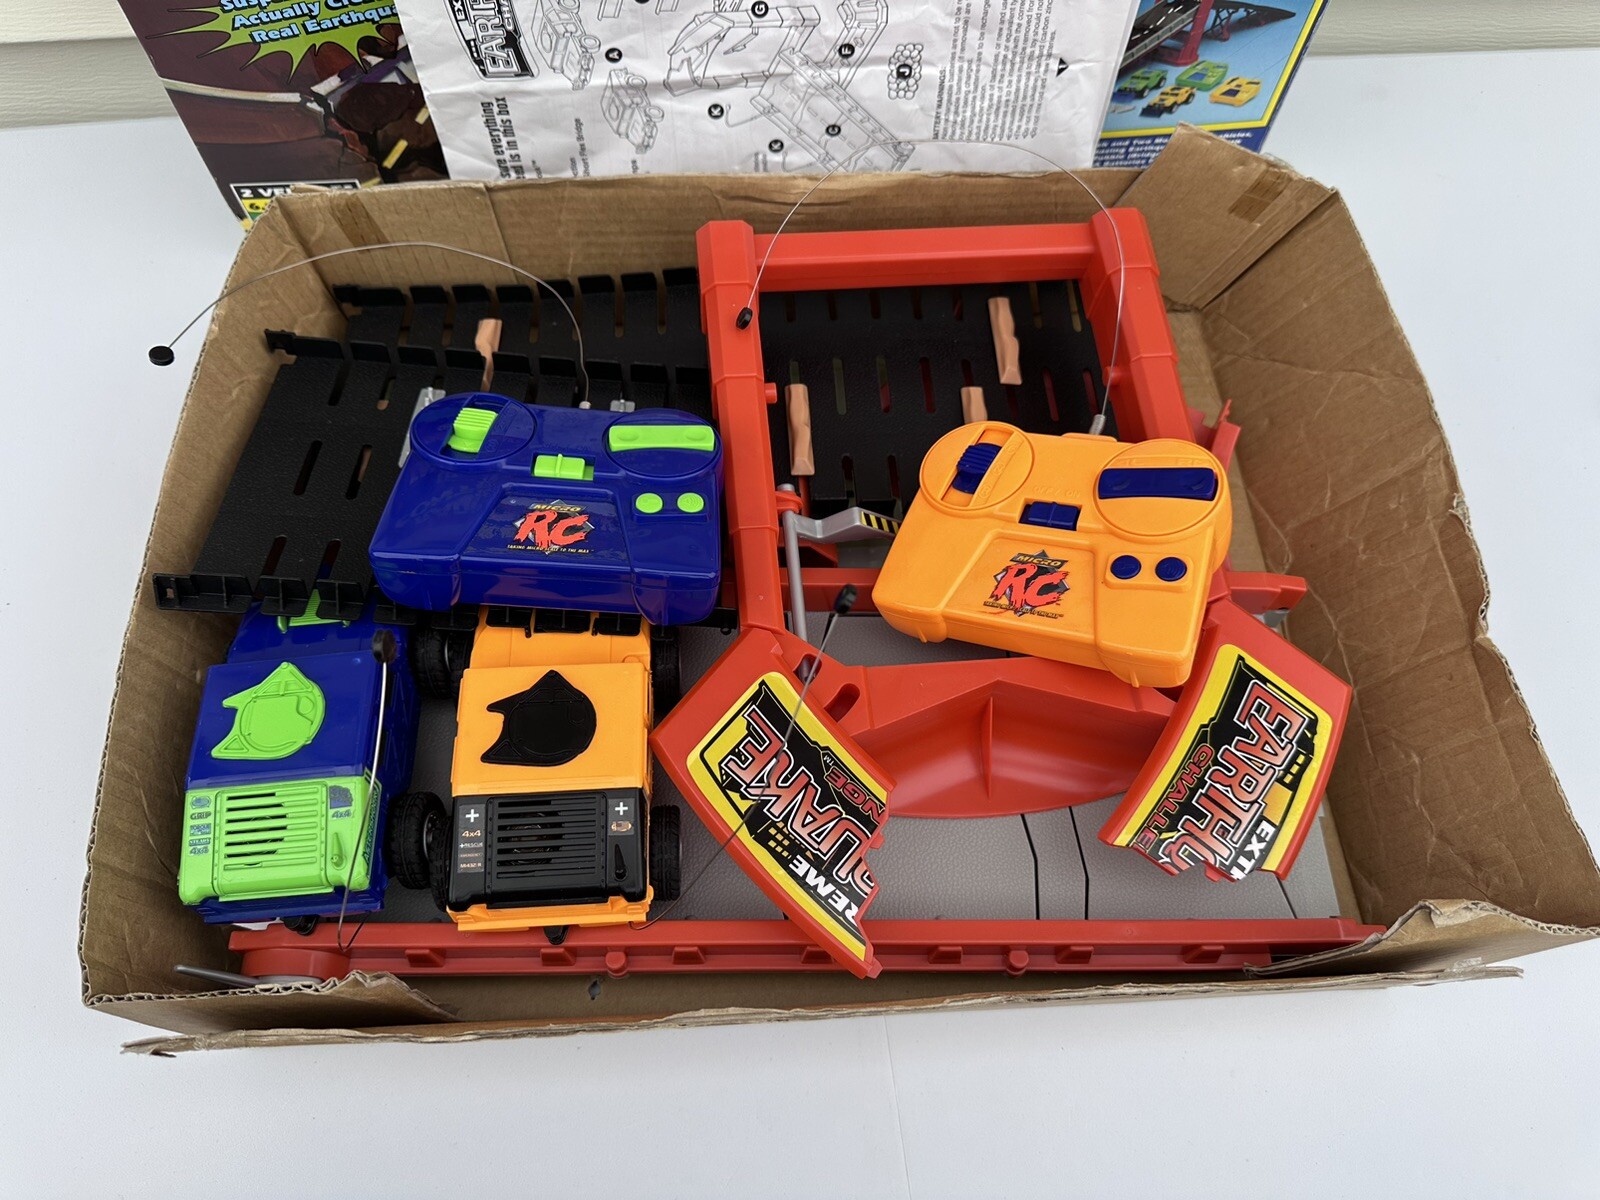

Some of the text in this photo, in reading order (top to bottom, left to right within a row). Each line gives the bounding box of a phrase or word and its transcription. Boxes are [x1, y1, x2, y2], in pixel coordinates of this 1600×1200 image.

[232, 1, 320, 29] Actually
[954, 7, 962, 15] be
[250, 23, 299, 43] Real
[978, 32, 985, 41] be
[1032, 13, 1042, 37] should
[955, 65, 963, 95] batteries
[960, 17, 970, 54] removable)
[1035, 45, 1045, 75] standard
[1040, 16, 1049, 43] (carbon
[1045, 30, 1056, 61] batteries.
[993, 95, 1002, 123] batteries
[1005, 8, 1015, 43] equivalent
[1008, 51, 1017, 77] inserted
[1013, 74, 1022, 104] batteries
[1022, 15, 1032, 45] removed
[936, 67, 946, 109] WARNINGS:
[1006, 79, 1012, 88] be
[1021, 71, 1031, 102] terminals
[494, 96, 510, 116] box
[1018, 104, 1026, 122] supply
[480, 101, 511, 178] sure everything
[500, 119, 516, 138] this
[574, 118, 584, 142] Bridge
[504, 140, 518, 150] in
[510, 154, 522, 162] is
[531, 504, 582, 512] MICRO
[514, 510, 590, 548] RC
[1016, 555, 1062, 566] MICRO
[988, 562, 1070, 610] RC
[462, 830, 482, 838] 4x4
